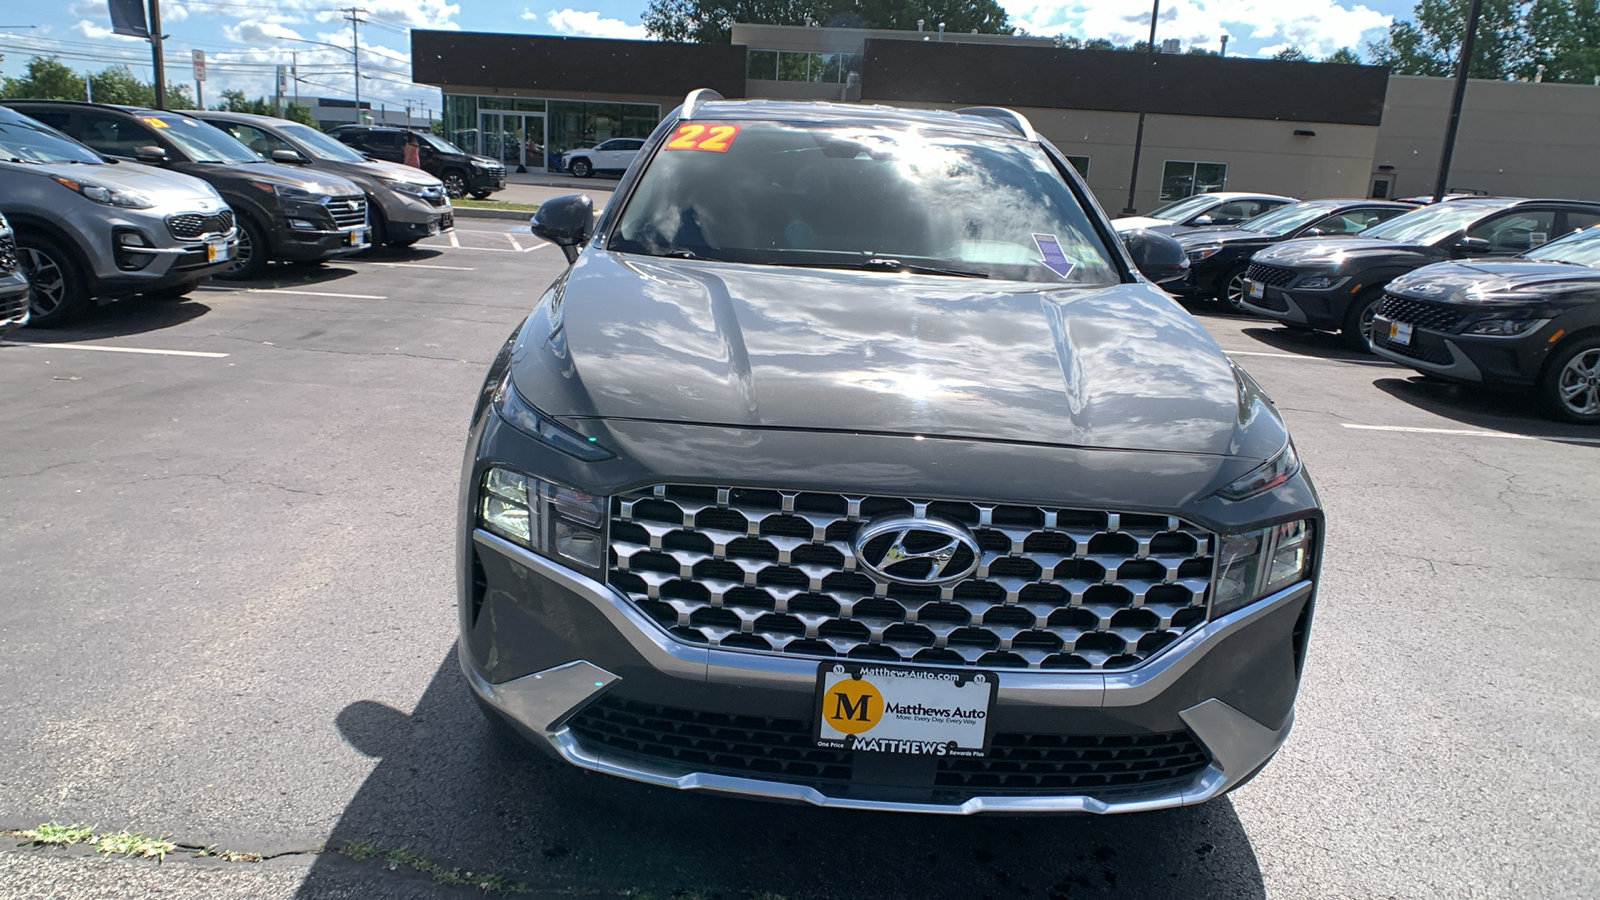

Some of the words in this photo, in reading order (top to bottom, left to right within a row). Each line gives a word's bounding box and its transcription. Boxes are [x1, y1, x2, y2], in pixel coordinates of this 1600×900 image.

[667, 124, 736, 149] 22
[859, 667, 959, 681] MatthewsAuto.com
[831, 692, 873, 722] M
[885, 702, 950, 718] Matthews
[951, 706, 986, 719] Auto
[914, 715, 931, 723] Every
[830, 741, 845, 749] Price
[851, 737, 947, 756] MATTHEWS
